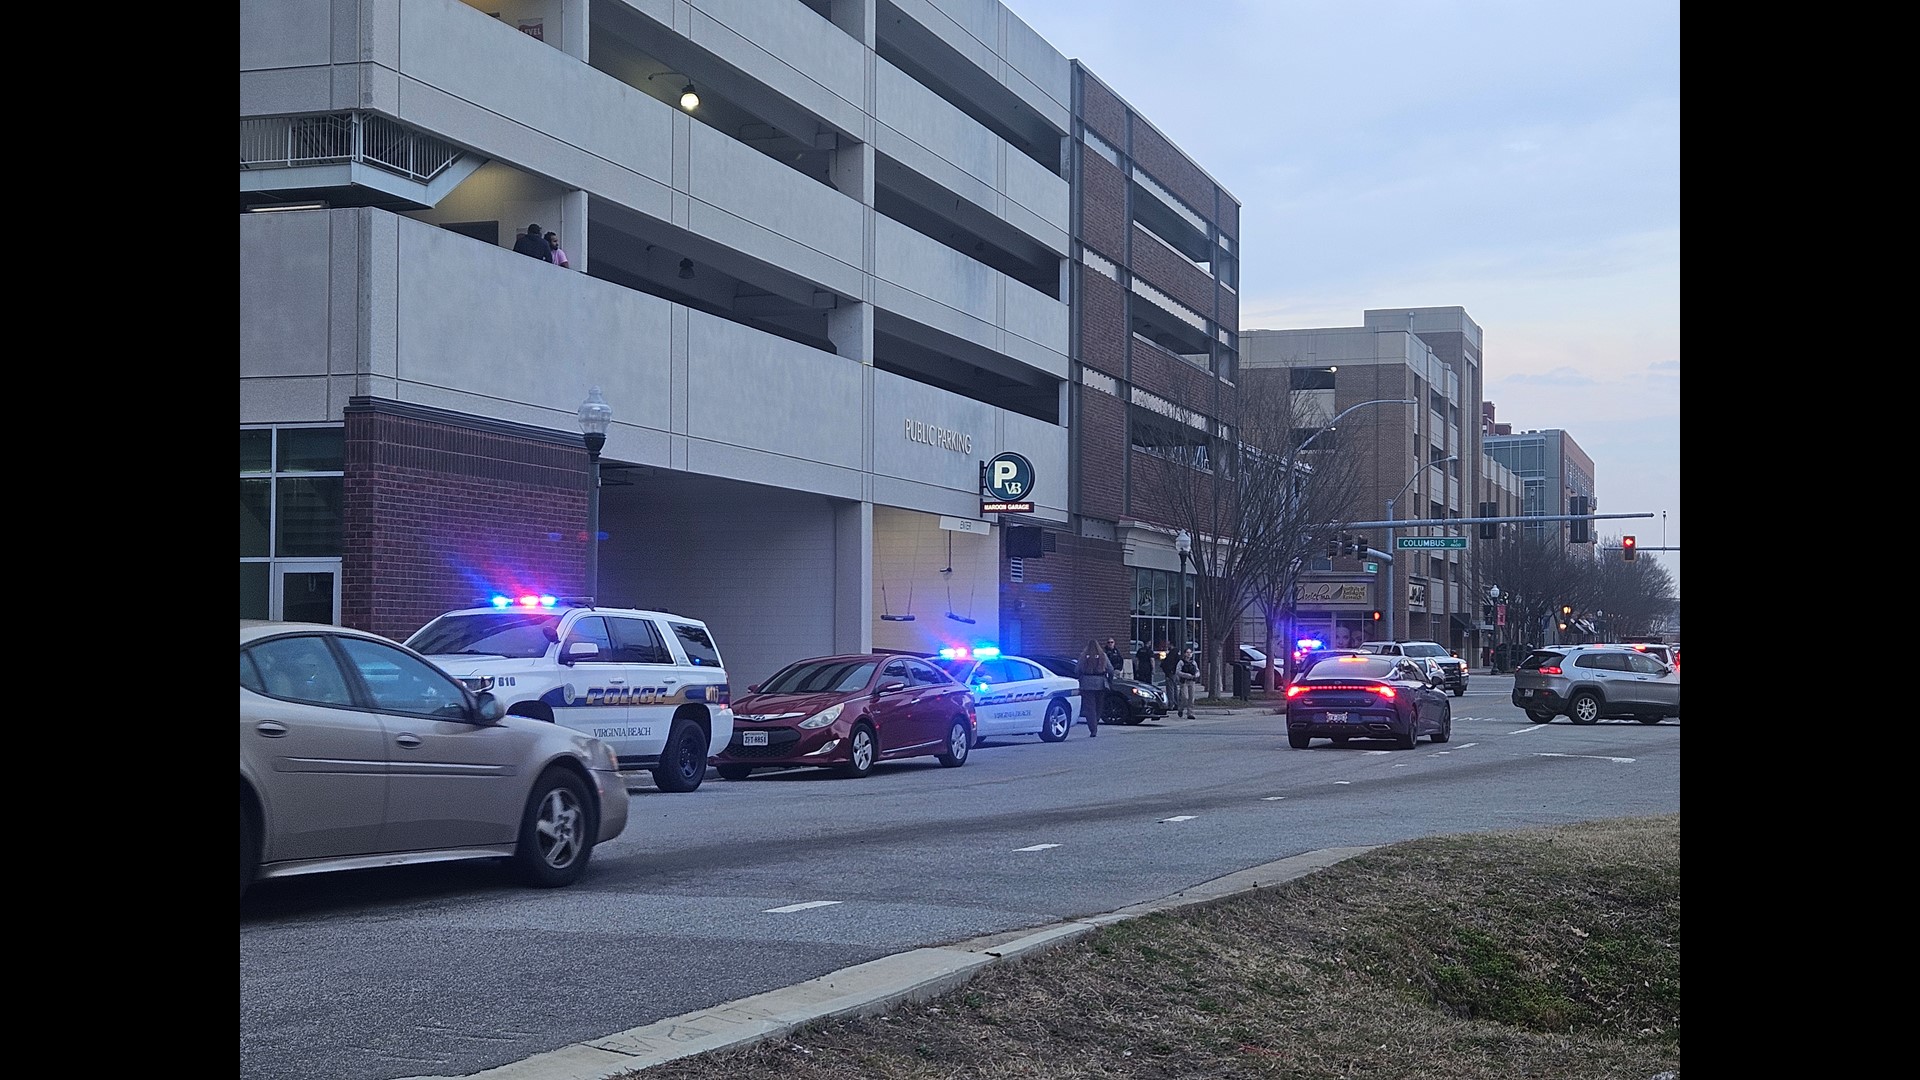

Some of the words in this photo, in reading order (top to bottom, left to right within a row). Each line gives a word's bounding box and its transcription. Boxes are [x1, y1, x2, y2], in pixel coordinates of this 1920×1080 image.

[904, 418, 936, 446] PUBLIC
[936, 427, 972, 455] PARKING
[993, 460, 1017, 489] P
[1007, 503, 1030, 511] GARAGE
[1402, 539, 1446, 548] COLUMBUS
[586, 687, 668, 705] POLICE
[593, 728, 627, 738] VIRGINIA
[627, 727, 651, 737] BEACH
